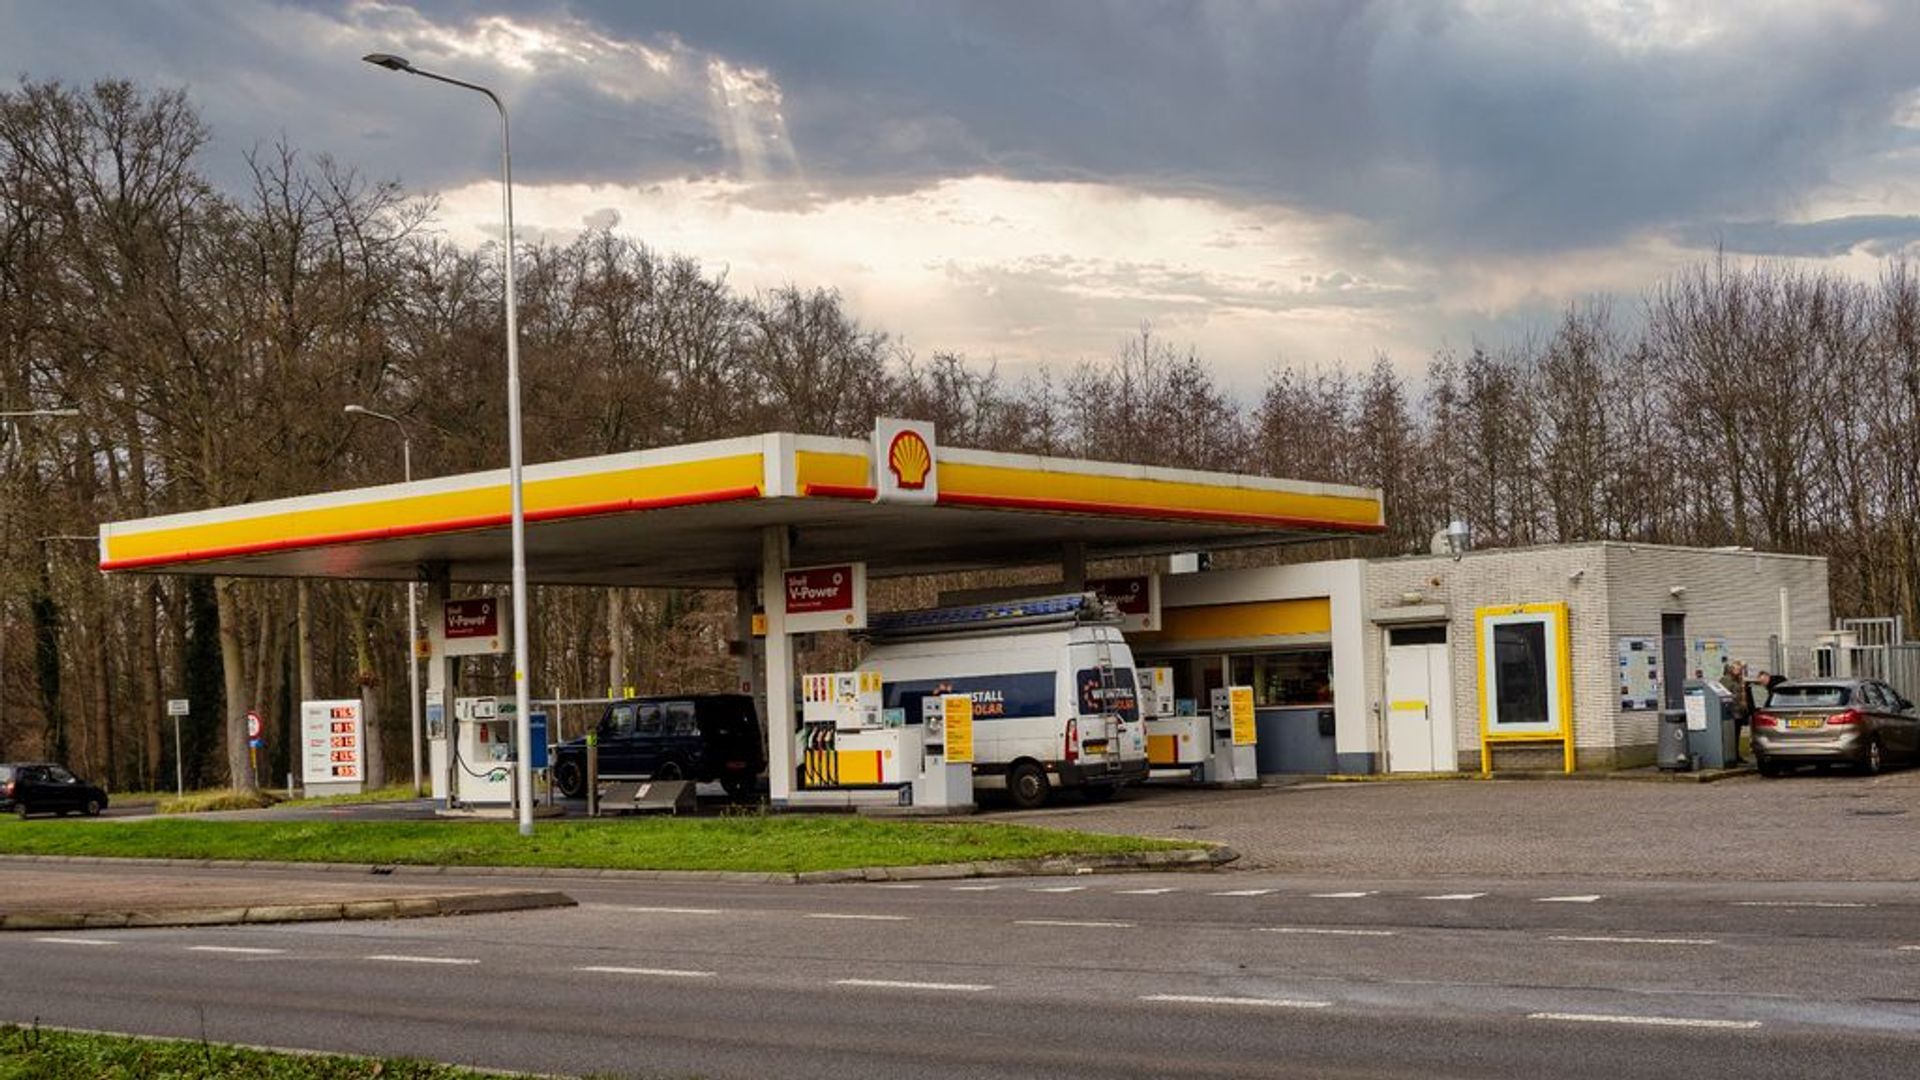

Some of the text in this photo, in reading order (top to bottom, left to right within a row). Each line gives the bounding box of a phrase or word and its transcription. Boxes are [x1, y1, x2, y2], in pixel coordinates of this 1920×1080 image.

[789, 587, 840, 600] V-Power
[971, 690, 1004, 702] STALL
[973, 703, 1004, 716] OLAR
